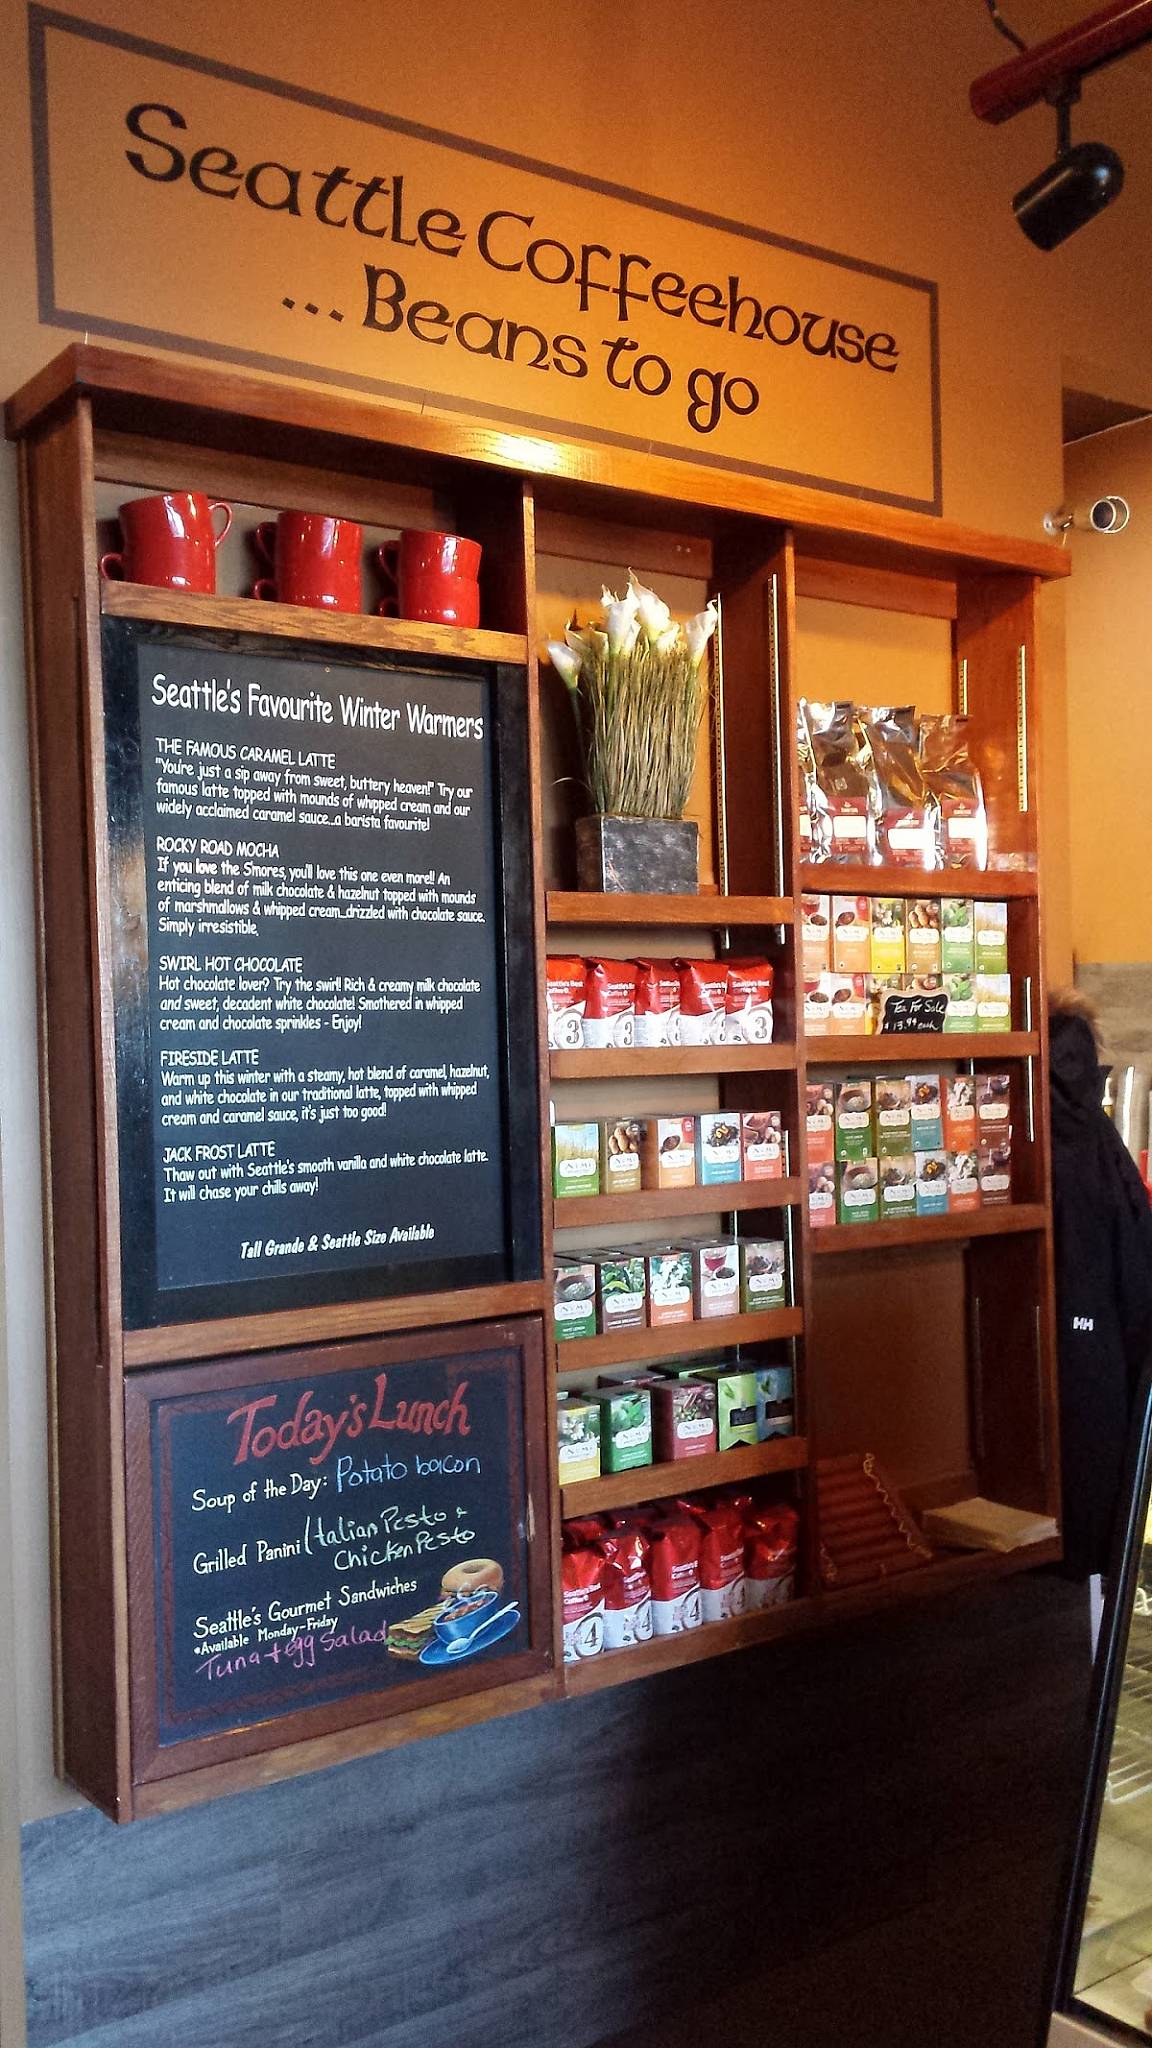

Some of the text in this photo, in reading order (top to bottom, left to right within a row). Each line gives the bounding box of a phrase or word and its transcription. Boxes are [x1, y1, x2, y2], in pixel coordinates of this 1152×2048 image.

[122, 101, 899, 374] Seattle Coffeehouse
[600, 331, 671, 396] to
[688, 371, 760, 433] go
[248, 684, 333, 722] Favourite
[339, 696, 400, 729] Winter
[406, 704, 484, 738] Warmers
[155, 737, 335, 769] THE FAMOUS CARAMEL LATTE
[156, 777, 431, 813] famous latte topped mounds whipped cream
[253, 771, 281, 787] away
[350, 775, 390, 795] buttery
[156, 798, 194, 819] widely
[196, 802, 249, 818] acclaimed
[252, 808, 295, 822] caramel
[344, 812, 381, 828] barista
[156, 836, 279, 857] ROCKY ROAD MOCHA
[157, 878, 476, 905] enticing blend milk chocolate hazelnut topped mounds
[174, 900, 249, 914] marshmallows
[264, 902, 305, 920] whipped
[411, 906, 455, 921] chocolate
[158, 917, 194, 936] Simply
[159, 956, 302, 972] SWIRL HOT CHOCOLATE
[183, 975, 235, 990] chocolate
[239, 976, 270, 991] lover?
[344, 977, 365, 991] Rich
[378, 981, 414, 997] creamy
[416, 977, 435, 991] milk
[437, 978, 480, 992] chocolate
[222, 995, 272, 1010] decadent
[275, 995, 303, 1010] white
[358, 995, 412, 1010] Smothered
[425, 996, 462, 1013] whipped
[160, 1019, 195, 1030] cream
[222, 1015, 272, 1030] chocolate
[275, 1014, 321, 1032] sprinkles
[566, 1019, 580, 1044] 3
[160, 1049, 259, 1066] FIRESIDE LATTE
[161, 1071, 194, 1086] Warm
[237, 1070, 271, 1083] winter
[367, 1065, 393, 1080] blend
[185, 1090, 214, 1105] white
[217, 1089, 266, 1103] chocolate
[301, 1086, 352, 1100] traditional
[384, 1083, 416, 1103] topped
[440, 1081, 477, 1099] whipped
[161, 1114, 196, 1126] cream
[222, 1107, 264, 1123] caramel
[162, 1141, 275, 1163] JACK FROST LATTE
[163, 1167, 195, 1181] Thaw
[297, 1157, 334, 1173] smooth
[336, 1155, 367, 1170] vanilla
[389, 1153, 415, 1167] white
[417, 1150, 461, 1165] chocolate
[199, 1185, 231, 1200] chase
[234, 1185, 258, 1201] your
[262, 1180, 287, 1195] chills
[241, 1224, 434, 1258] Tall Grande Seattle Size Available
[1073, 1316, 1094, 1331] HH
[227, 1372, 471, 1465] Today's Lunch
[336, 1454, 482, 1493] Potato bacon
[191, 1473, 328, 1513] Soup of the Day:
[380, 1505, 447, 1534] Pesto
[193, 1539, 301, 1575] Grilled Panini
[334, 1526, 476, 1571] Chicken Pesto
[193, 1576, 418, 1639] Seattle's Gourmet Sandwiches
[584, 1622, 599, 1648] 4
[195, 1652, 261, 1681] Tuna
